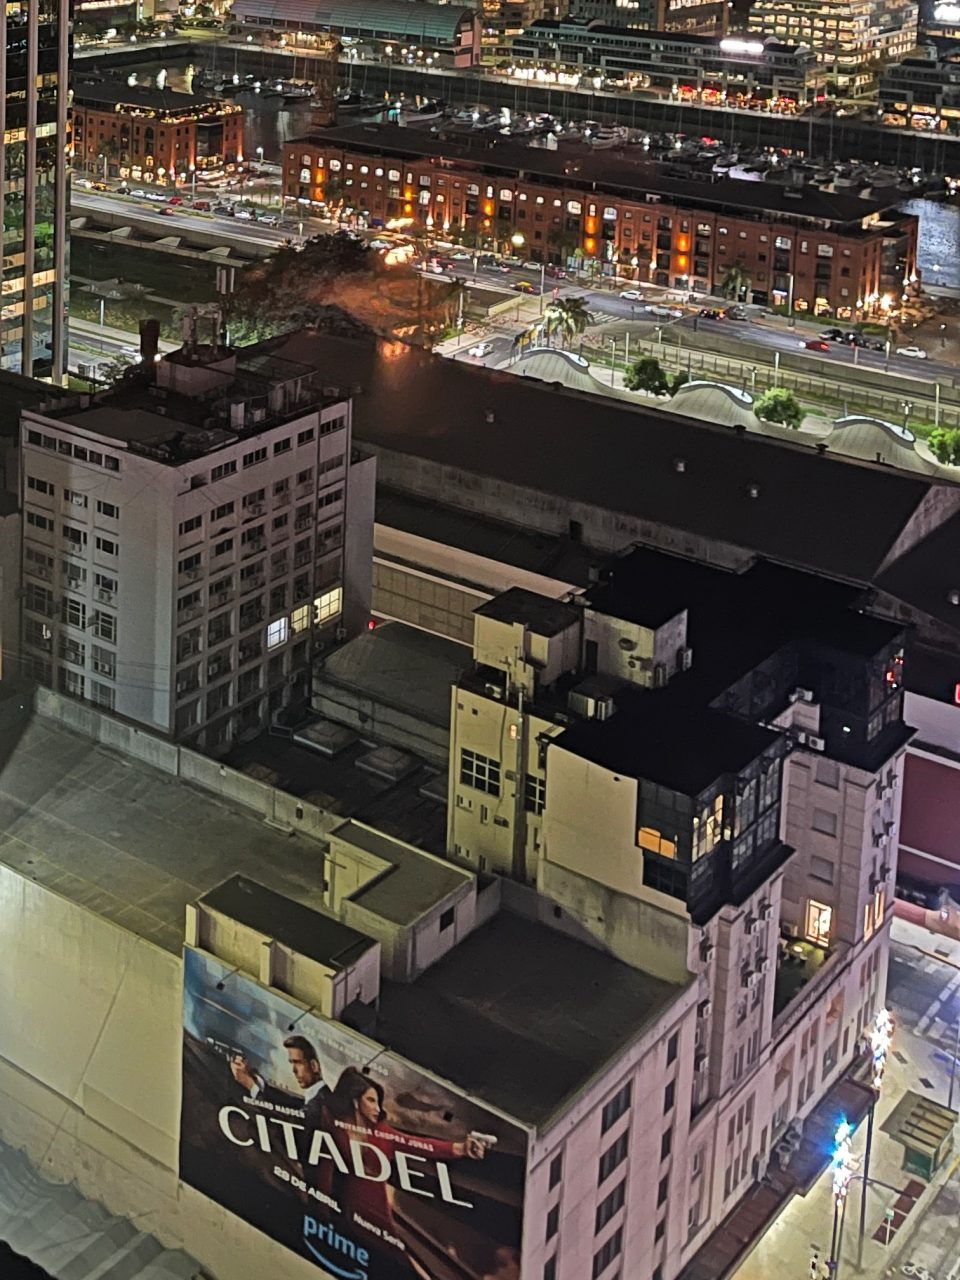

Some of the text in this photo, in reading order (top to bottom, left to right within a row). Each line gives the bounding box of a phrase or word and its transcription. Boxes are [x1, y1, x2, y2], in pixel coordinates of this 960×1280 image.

[218, 1105, 474, 1209] CITADEL
[291, 1175, 307, 1192] DE
[303, 1215, 369, 1267] prime
[353, 1212, 406, 1251] Nueva Serie
